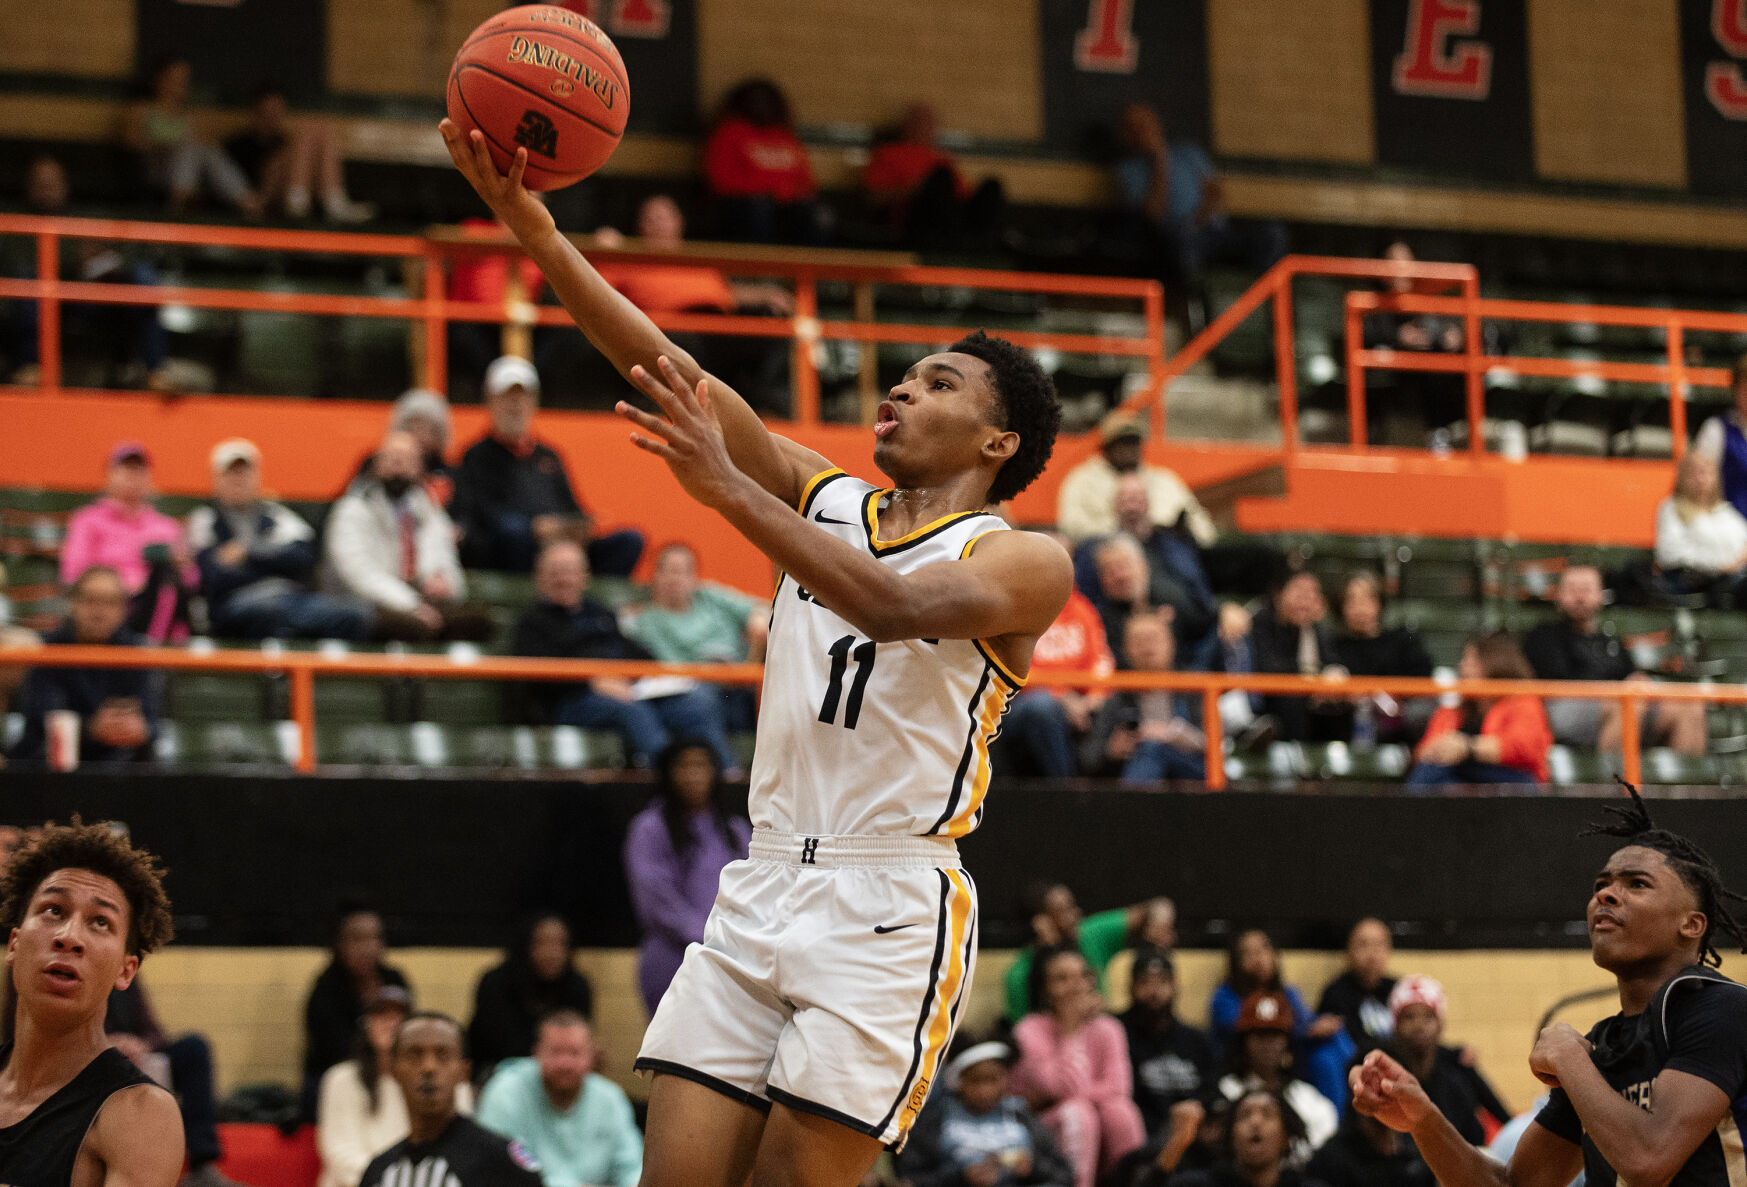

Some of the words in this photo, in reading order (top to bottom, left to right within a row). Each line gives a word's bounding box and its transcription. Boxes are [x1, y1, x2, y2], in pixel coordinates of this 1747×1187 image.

[507, 35, 619, 110] SPALDING
[817, 634, 877, 730] 11
[800, 837, 820, 865] H
